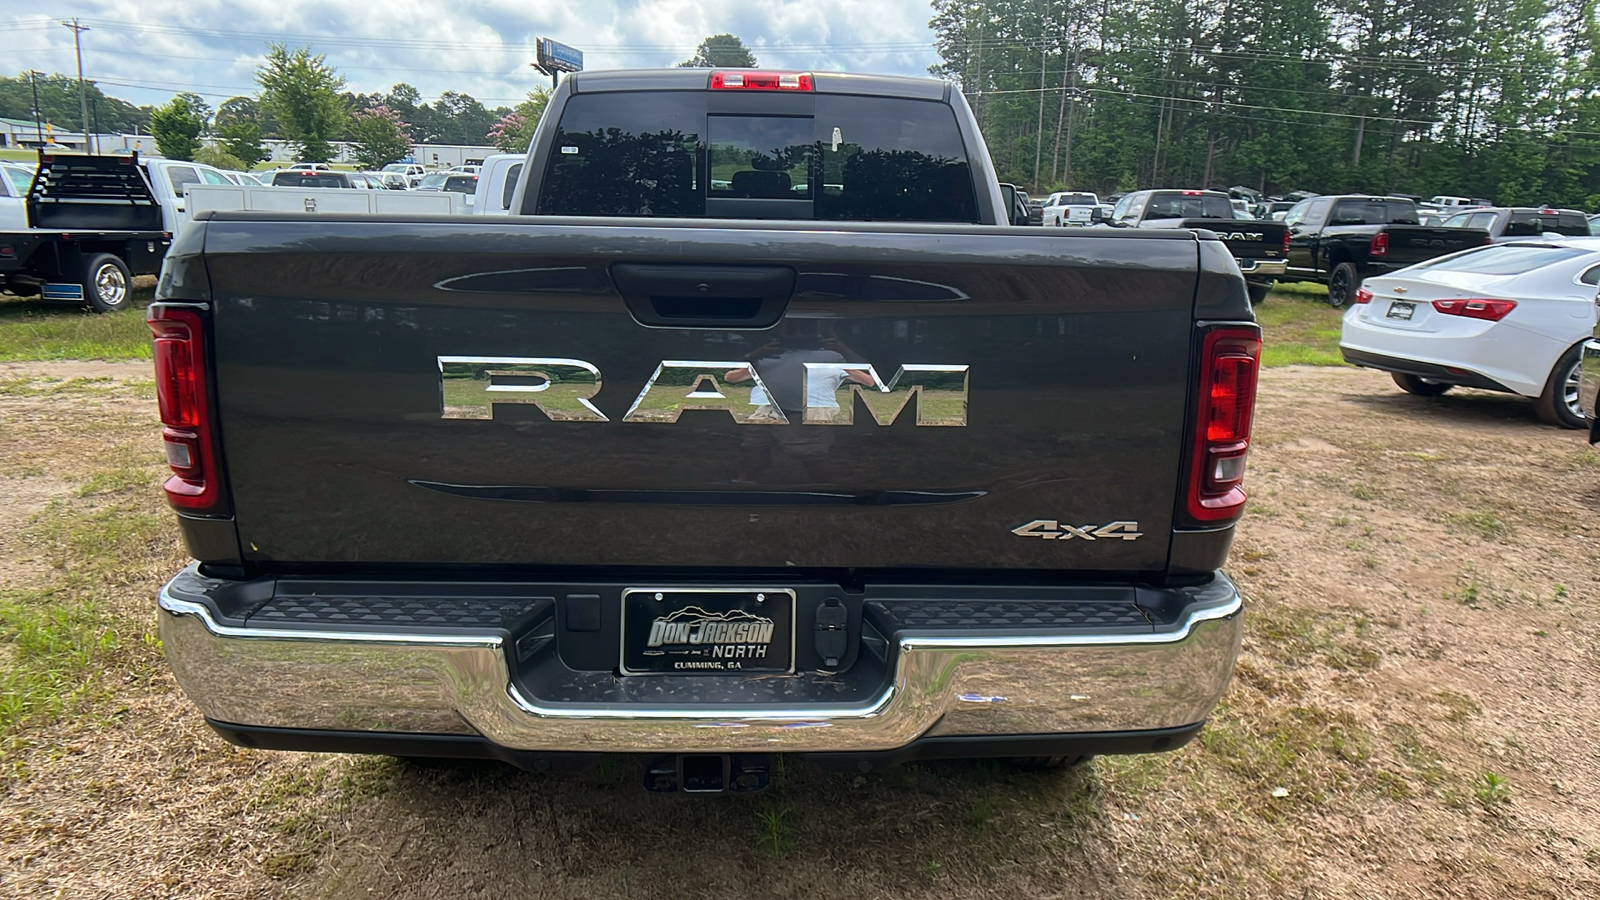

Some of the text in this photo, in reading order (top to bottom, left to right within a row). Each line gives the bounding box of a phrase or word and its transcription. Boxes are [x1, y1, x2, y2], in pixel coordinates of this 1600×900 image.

[1411, 238, 1464, 247] RAM
[437, 356, 970, 426] RAM
[1011, 520, 1143, 540] 4x4
[712, 645, 767, 658] NORTH
[674, 662, 724, 670] CUMMING,
